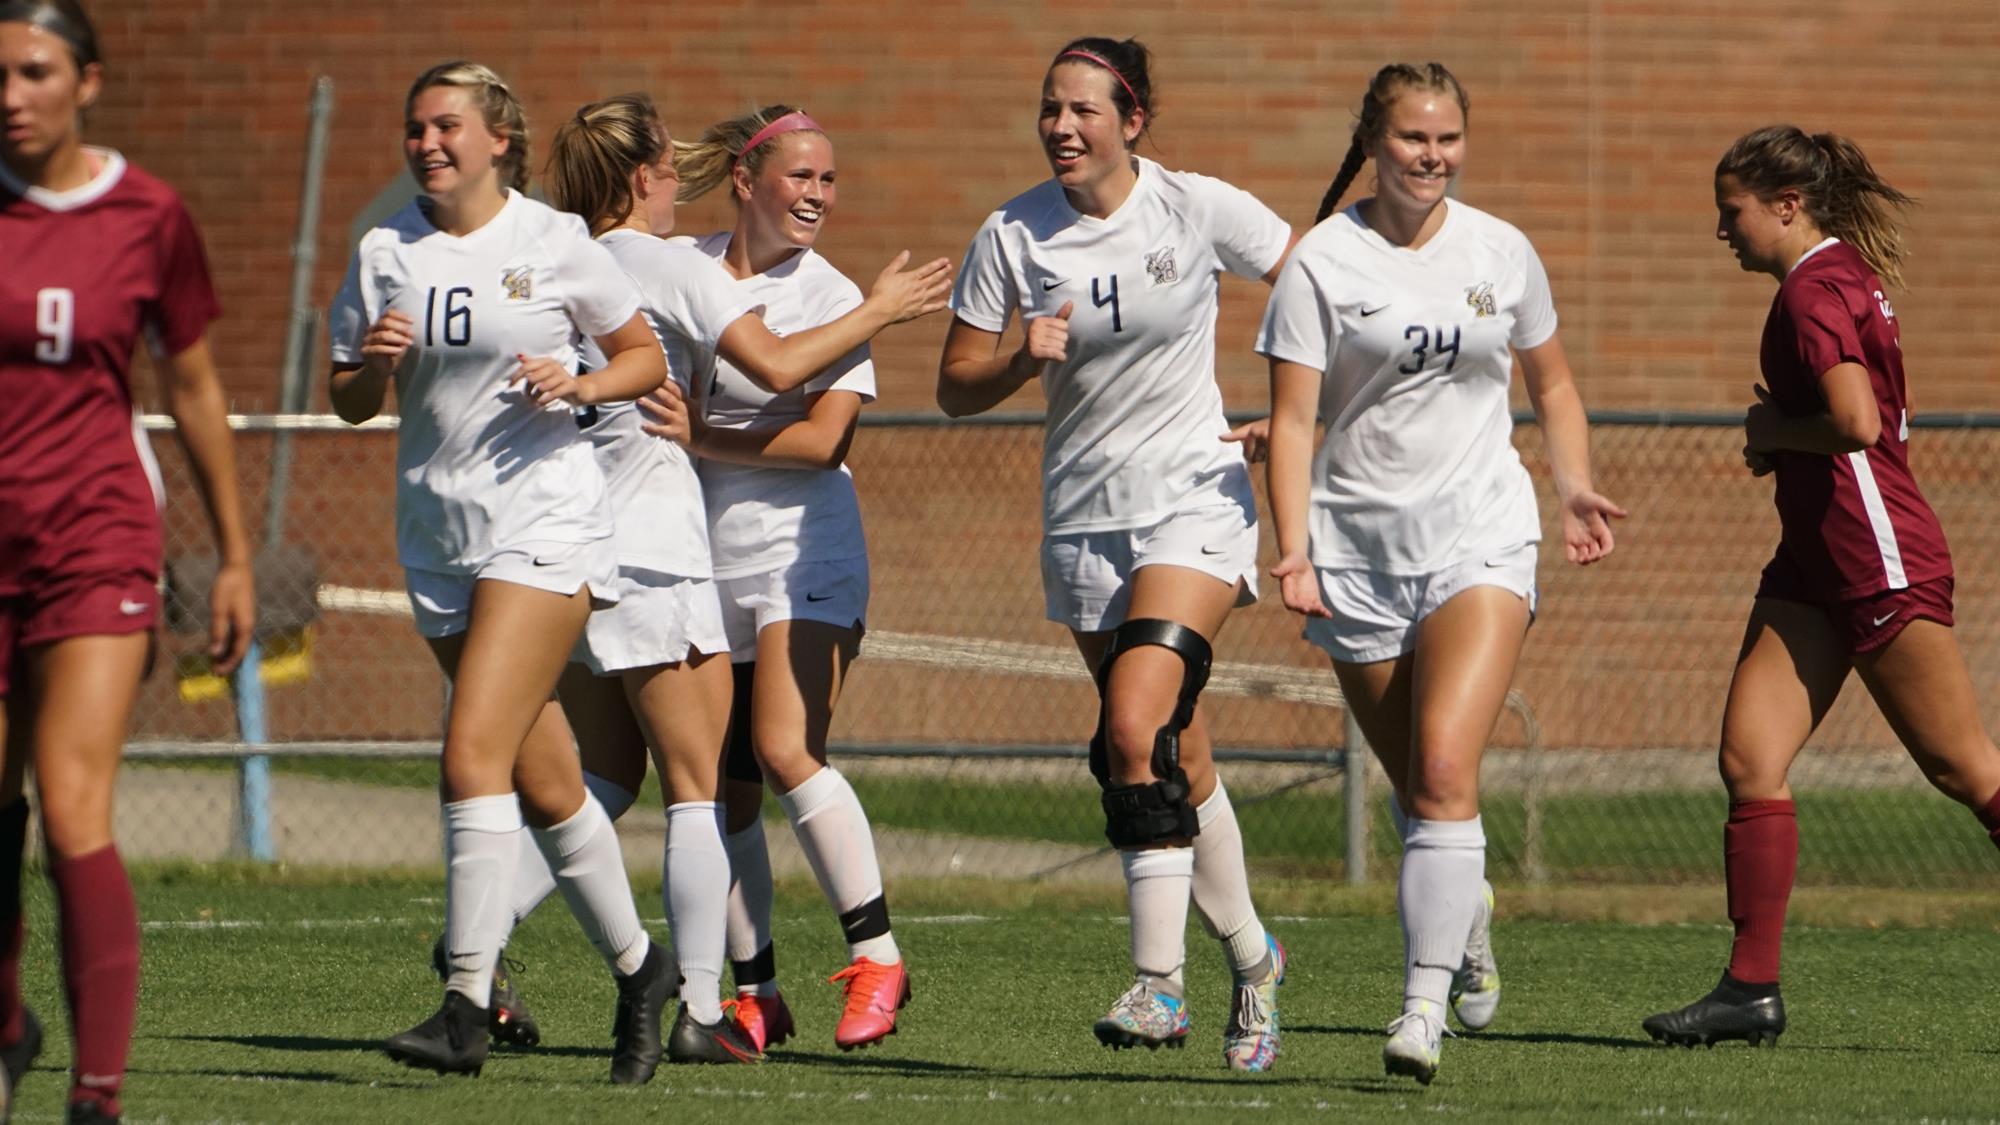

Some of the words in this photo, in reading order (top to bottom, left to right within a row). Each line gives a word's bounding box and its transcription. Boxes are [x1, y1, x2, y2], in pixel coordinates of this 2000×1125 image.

[36, 287, 75, 363] 9
[425, 286, 473, 346] 16
[1091, 274, 1123, 332] 4
[1399, 325, 1461, 375] 34
